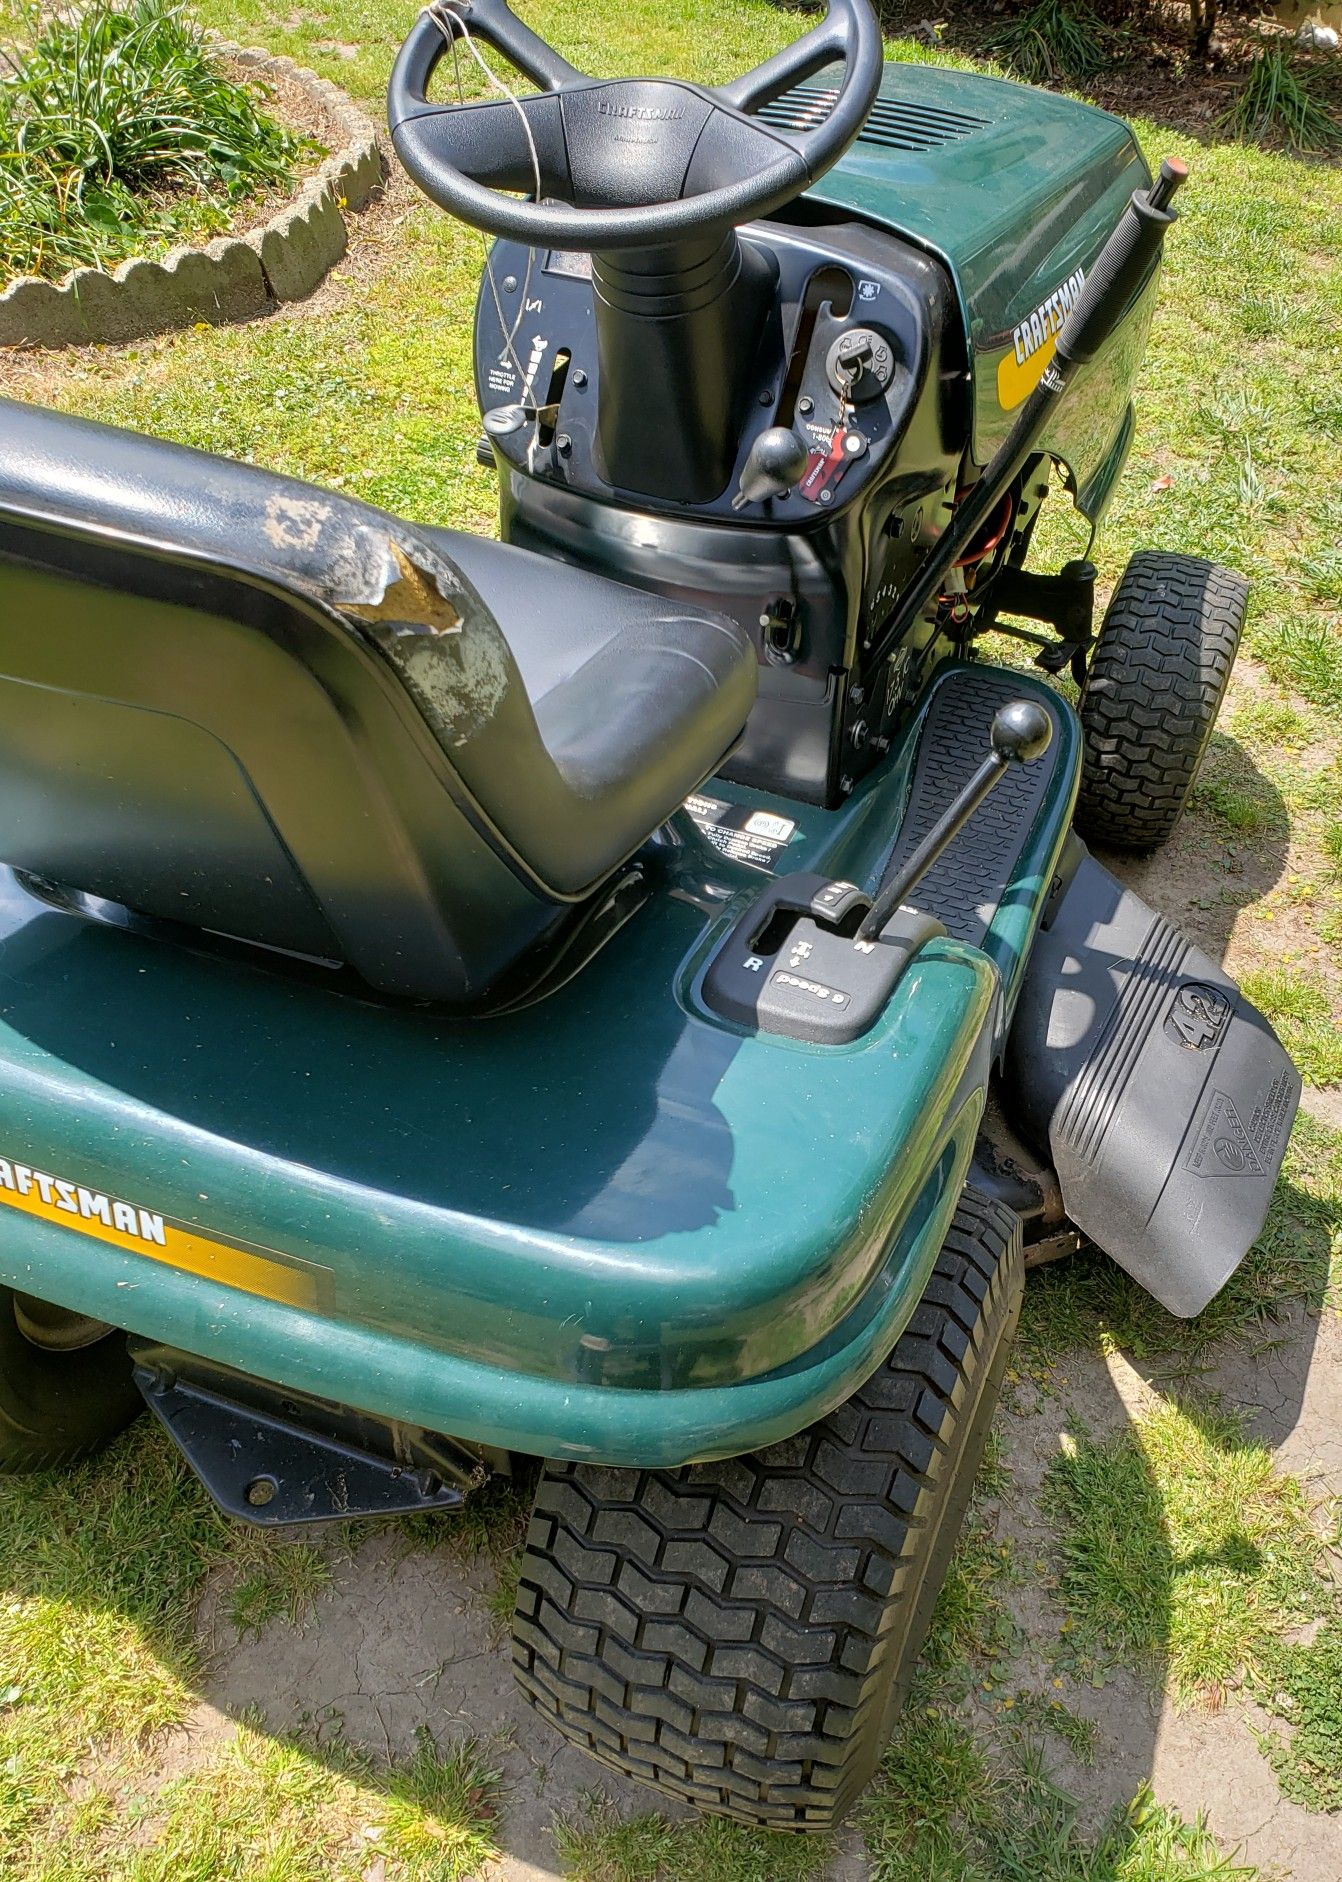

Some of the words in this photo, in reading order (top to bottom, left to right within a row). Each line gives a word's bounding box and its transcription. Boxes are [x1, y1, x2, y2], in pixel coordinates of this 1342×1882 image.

[806, 424, 832, 434] CONSUM
[743, 957, 764, 972] R
[1224, 1108, 1261, 1173] DANGER
[0, 1158, 167, 1246] AFTSMAN
